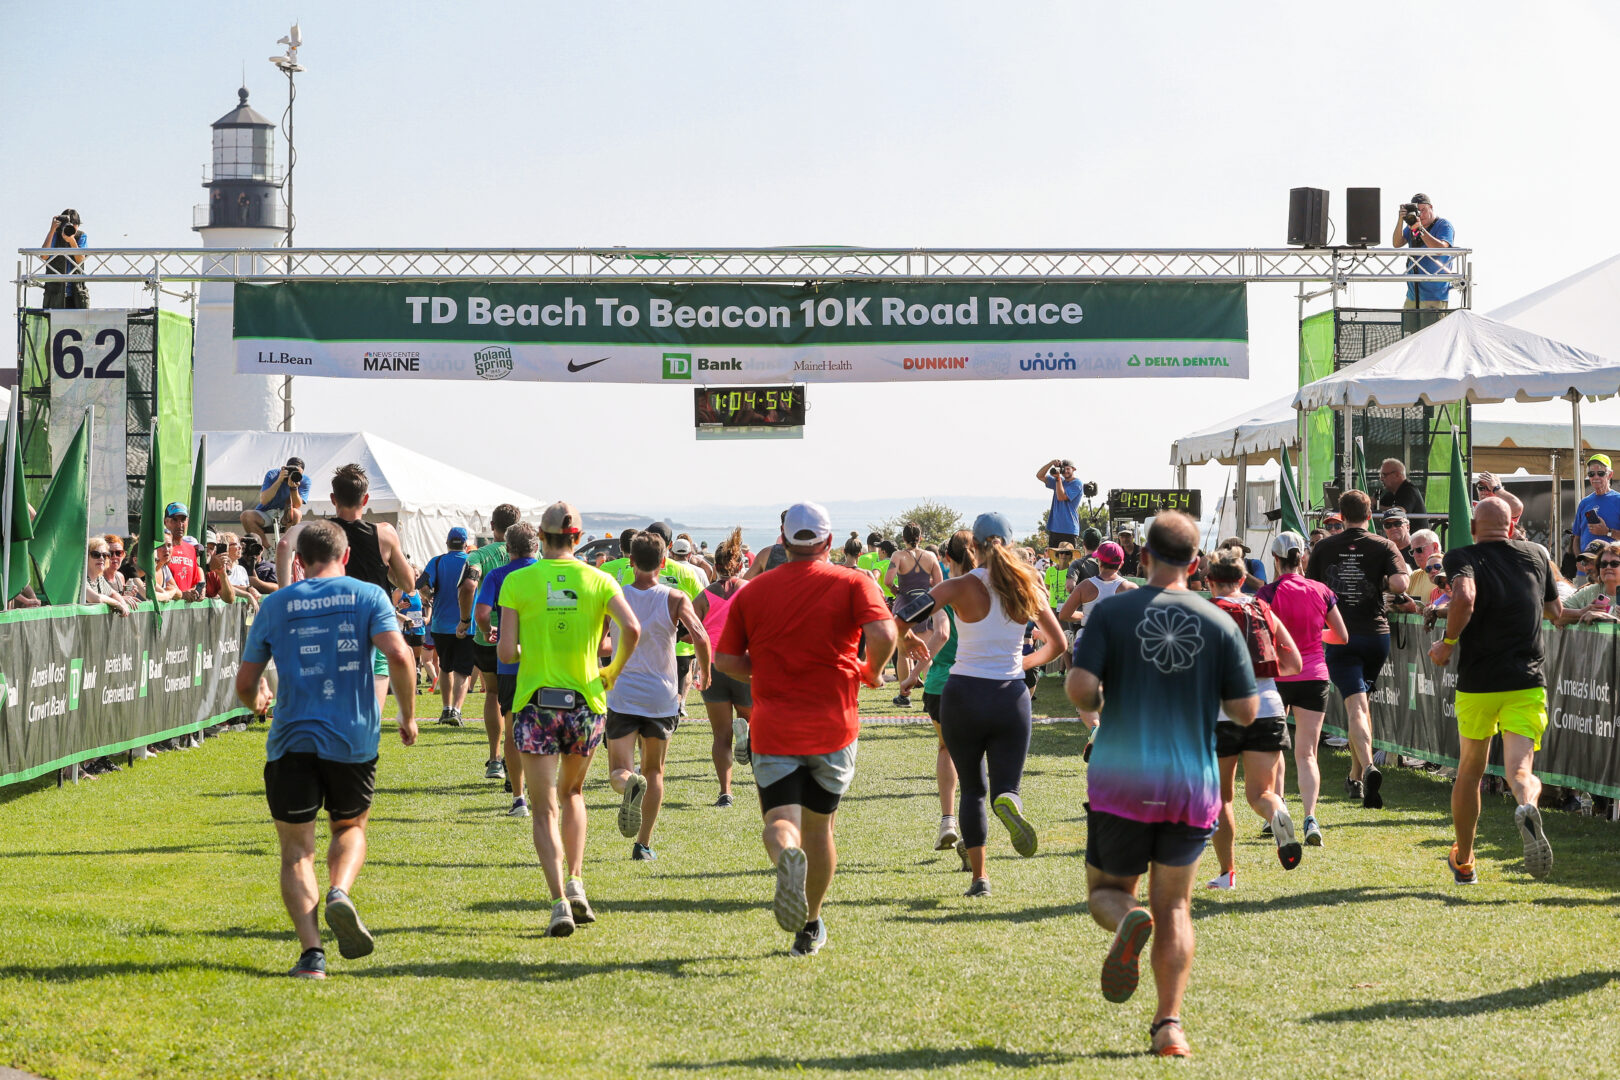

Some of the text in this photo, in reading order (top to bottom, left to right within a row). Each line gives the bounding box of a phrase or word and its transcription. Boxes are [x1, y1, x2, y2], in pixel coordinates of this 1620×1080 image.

[406, 297, 1084, 328] TD Beach To Beacon 10K Road Race
[52, 328, 125, 379] 6.2
[258, 352, 312, 366] L.L.Bean
[474, 347, 512, 364] Poland
[363, 357, 420, 371] MAINE
[475, 358, 513, 376] Spring
[666, 357, 689, 375] TD
[697, 357, 742, 371] Bank
[794, 360, 853, 371] MaineHealth
[903, 356, 969, 370] DUNKIN'
[1020, 352, 1076, 371] unum
[1145, 357, 1230, 367] DELTA DENTAL
[170, 555, 194, 567] AIRFIELD
[287, 594, 356, 613] #BOSTONTRI
